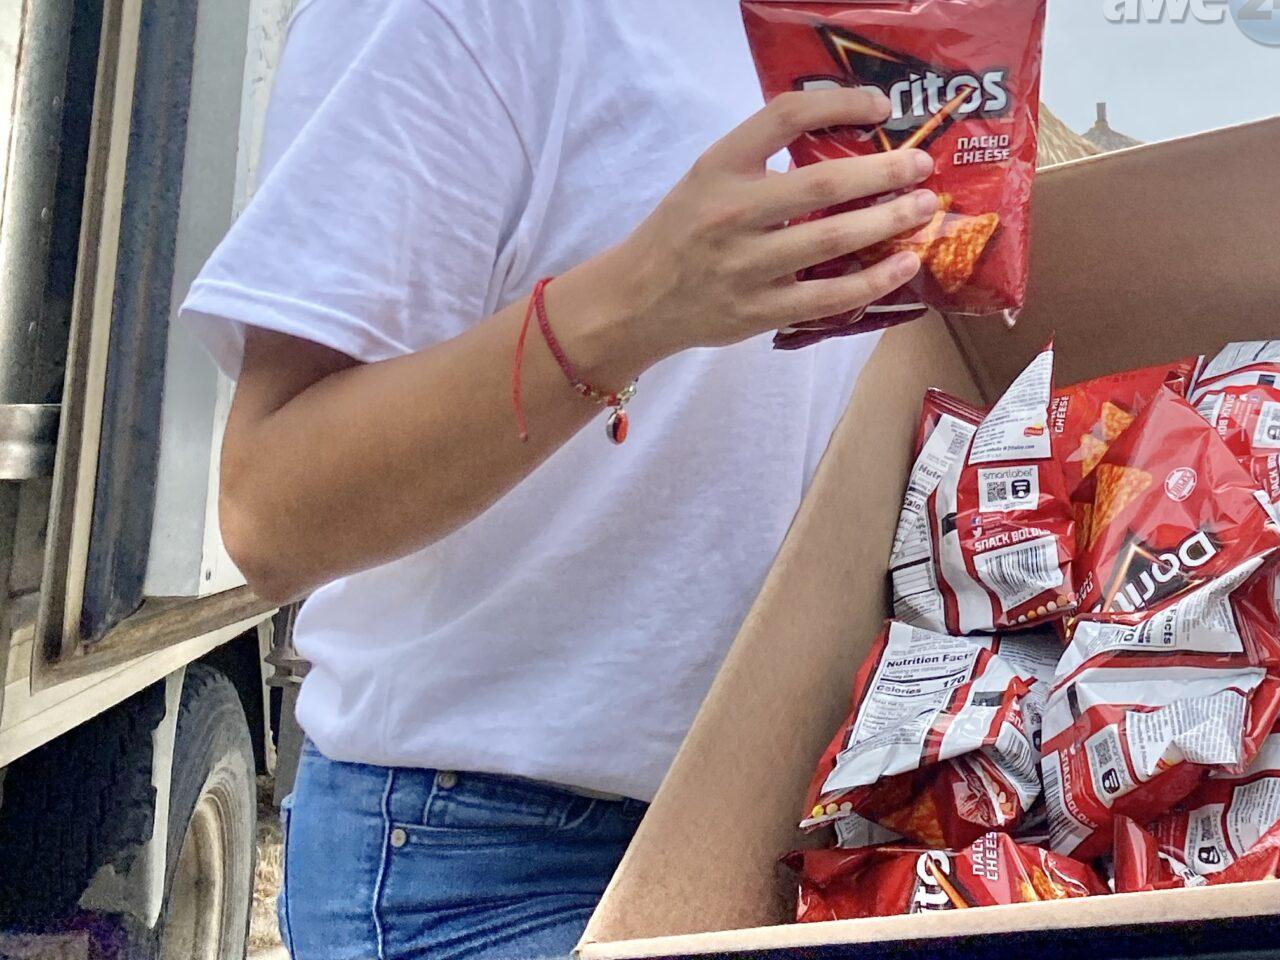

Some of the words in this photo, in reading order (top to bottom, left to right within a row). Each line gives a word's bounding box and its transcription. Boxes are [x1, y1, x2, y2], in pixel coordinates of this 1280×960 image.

[803, 71, 1008, 119] ritos
[957, 134, 1009, 150] NACHO
[953, 149, 1010, 166] CHEESE
[974, 534, 1010, 553] SNACK
[1163, 608, 1177, 644] Facts
[886, 655, 940, 668] Nutrition
[876, 684, 922, 695] Calories
[942, 674, 966, 688] 170
[985, 831, 999, 881] CHEES
